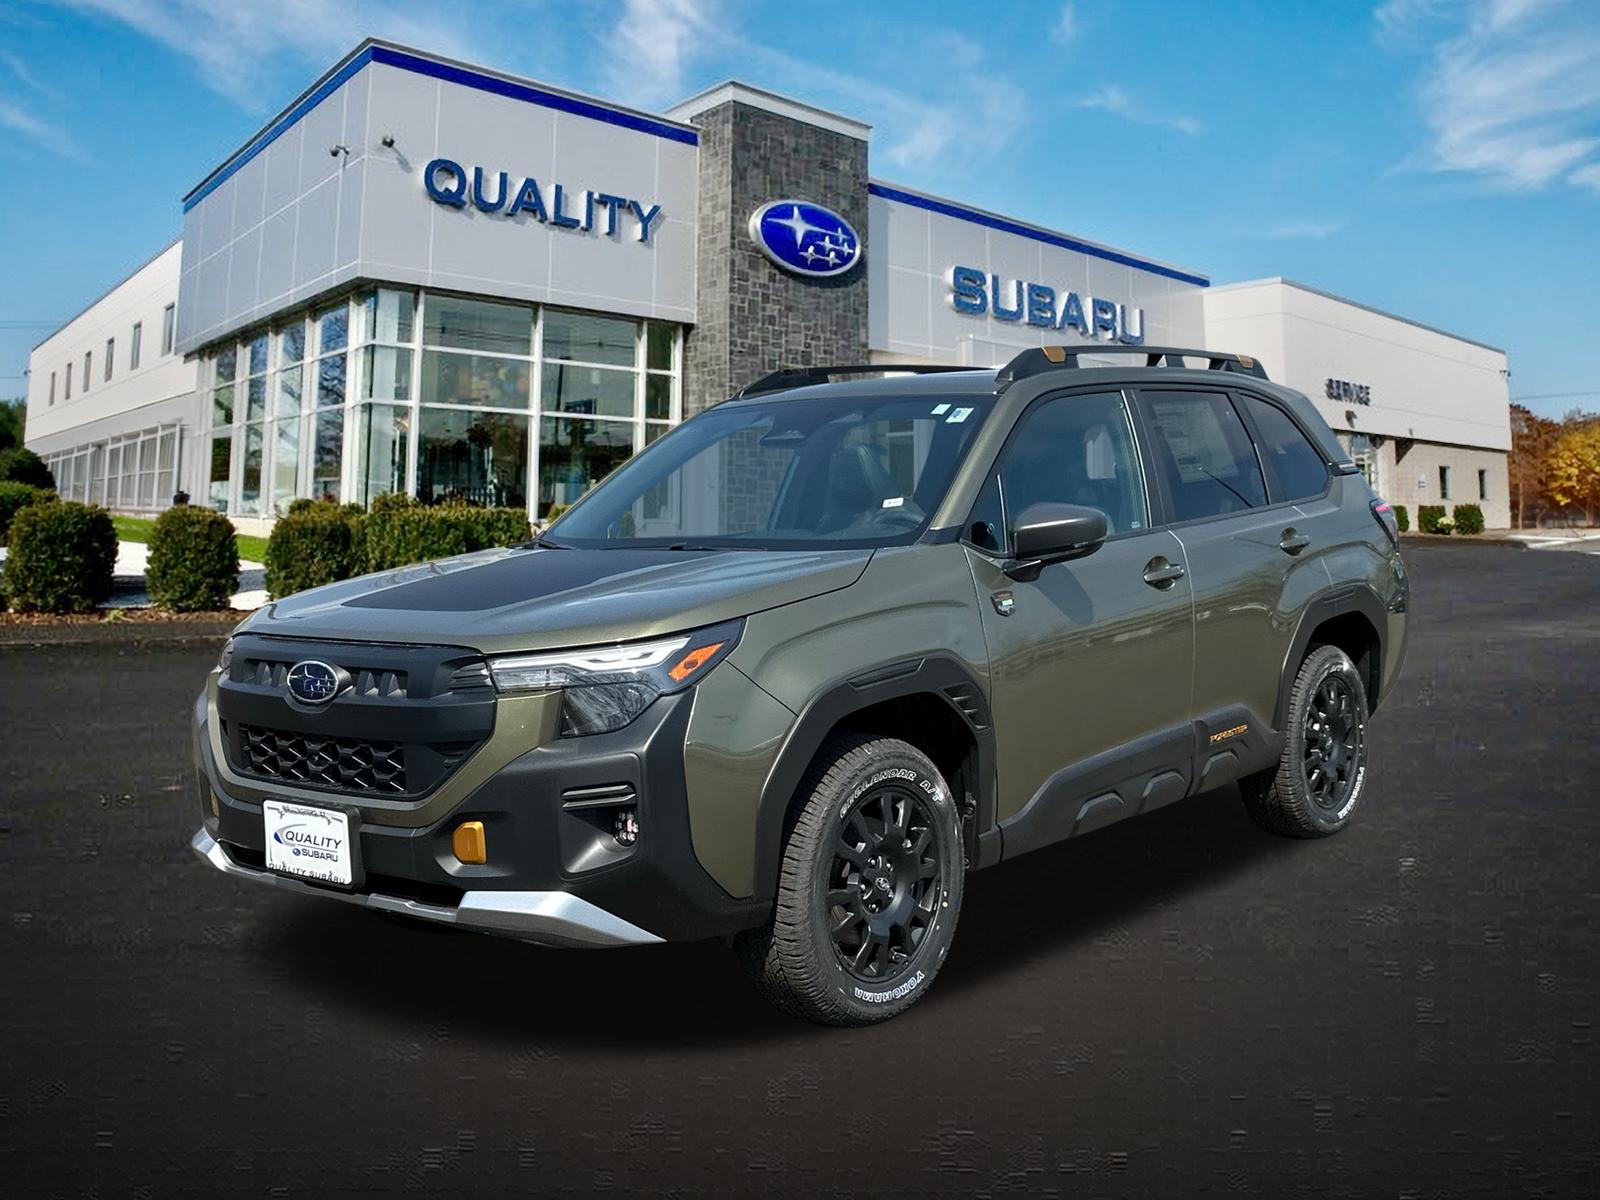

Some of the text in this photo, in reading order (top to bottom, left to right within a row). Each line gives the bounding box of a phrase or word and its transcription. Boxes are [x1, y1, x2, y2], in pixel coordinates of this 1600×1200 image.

[423, 158, 662, 243] QUALITY
[949, 265, 1145, 345] SUBARU
[919, 780, 944, 804] A/T
[285, 830, 342, 849] QUALITY
[301, 848, 339, 863] SUBARU
[268, 862, 307, 876] QUALITY
[854, 970, 925, 1003] YOKOHAMA
